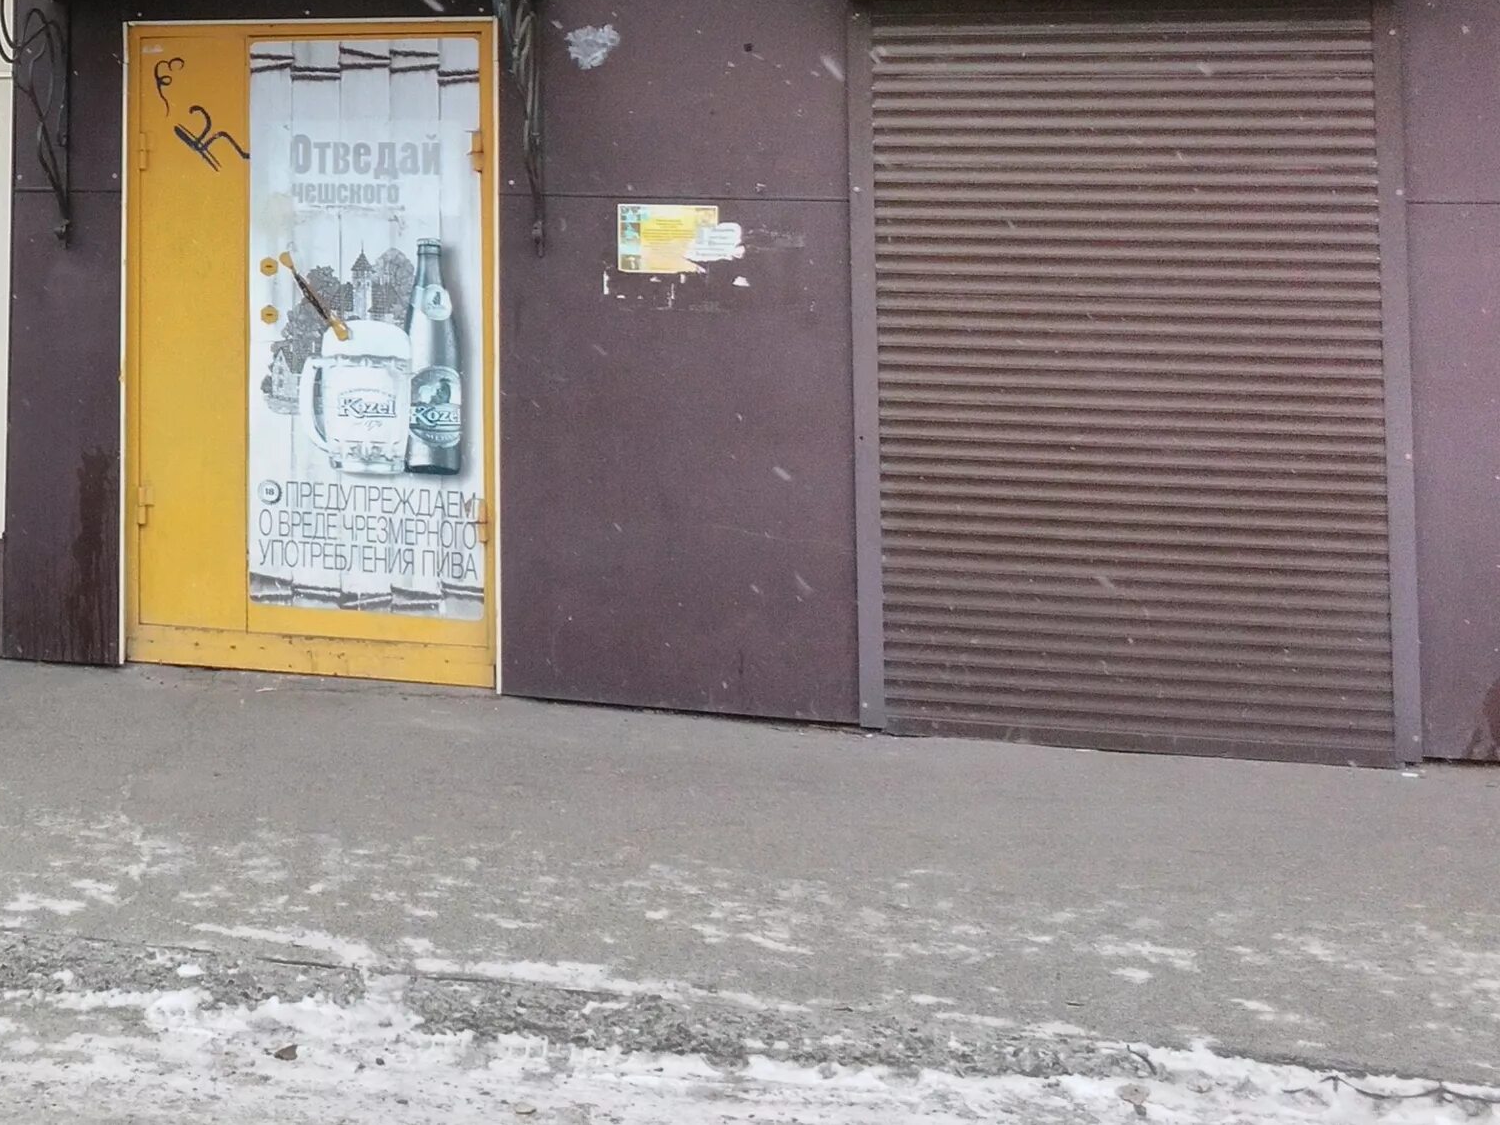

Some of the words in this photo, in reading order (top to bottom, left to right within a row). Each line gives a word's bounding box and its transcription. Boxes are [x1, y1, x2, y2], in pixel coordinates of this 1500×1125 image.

[290, 133, 442, 179] Отведай
[291, 182, 400, 204] чешского
[338, 398, 396, 418] Kozel
[286, 481, 476, 519] ПРЕДУПРЕЖДАЕМ
[259, 509, 272, 536] О
[279, 510, 337, 540] ВРЕДЕ
[343, 514, 477, 550] ЧРЕЗМЕРНОГО
[259, 539, 414, 575] УПОТРЕБЛЕНИЯ
[422, 549, 478, 580] ПИВА
